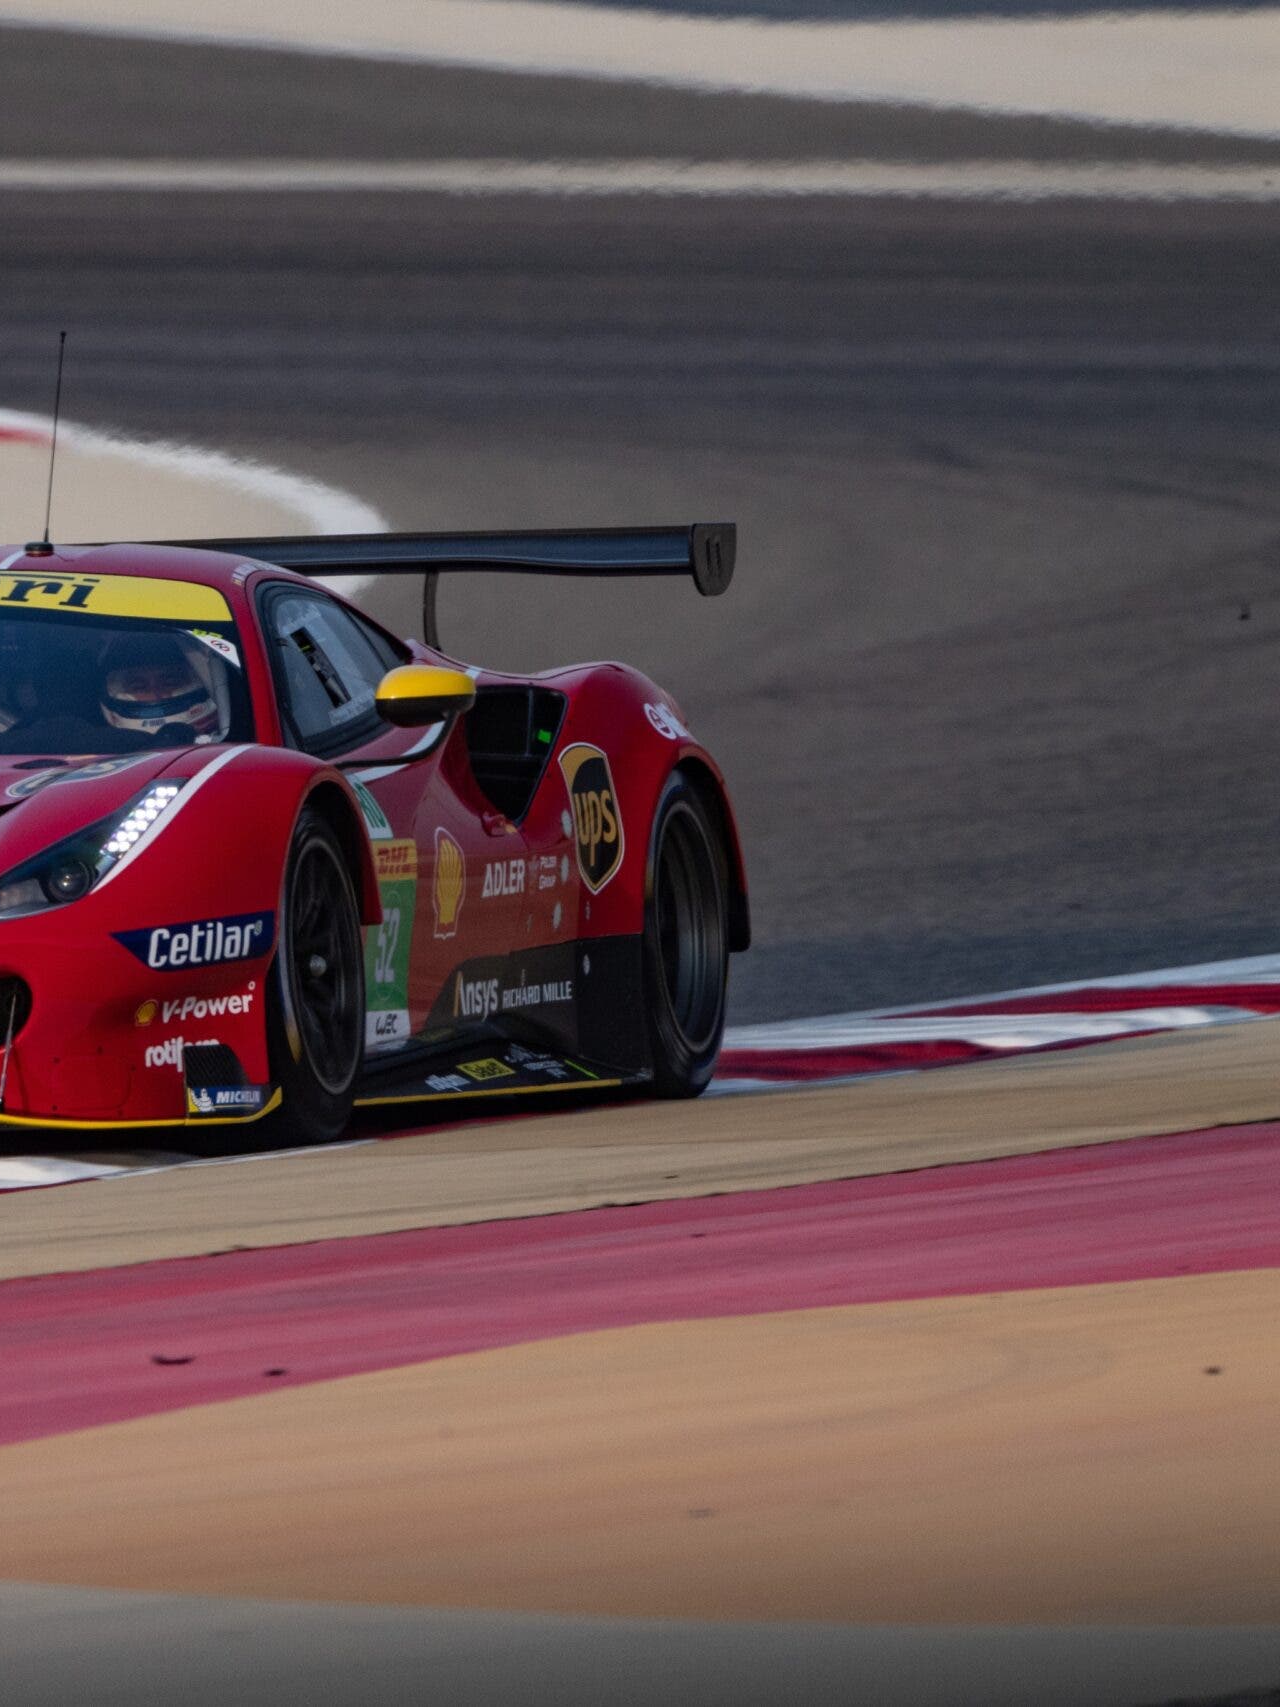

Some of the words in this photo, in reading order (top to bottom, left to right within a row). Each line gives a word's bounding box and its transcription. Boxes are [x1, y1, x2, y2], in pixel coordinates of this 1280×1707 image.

[573, 789, 618, 867] ups
[481, 859, 526, 899] ADLER
[161, 994, 254, 1024] V-Power
[453, 971, 499, 1022] Ansys
[502, 984, 542, 1009] RICHARD
[542, 980, 573, 1002] MILLE
[144, 1036, 220, 1073] rotif
